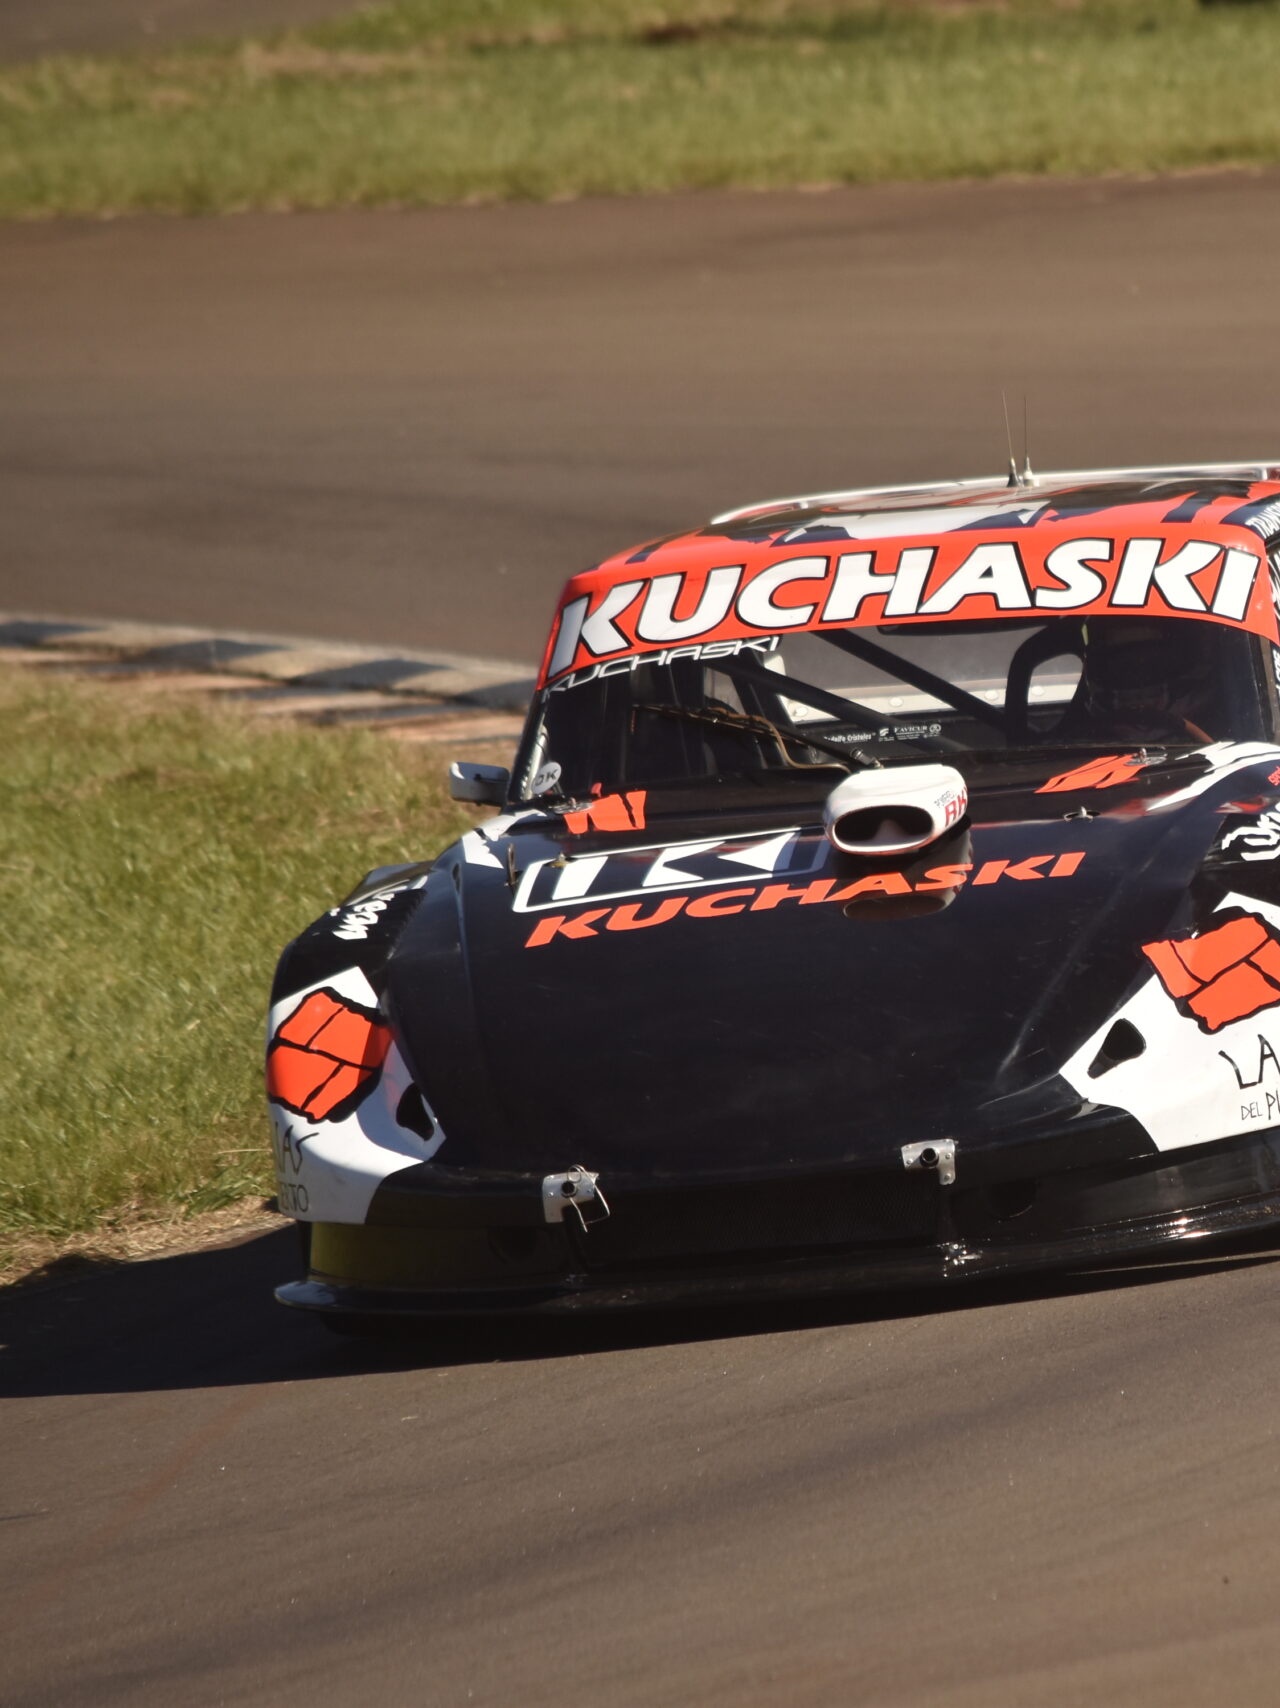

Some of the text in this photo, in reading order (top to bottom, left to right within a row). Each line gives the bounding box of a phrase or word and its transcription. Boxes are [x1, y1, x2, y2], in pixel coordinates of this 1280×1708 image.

[546, 537, 1261, 678] KUCHASKI
[543, 636, 780, 692] KUCHASKI
[524, 852, 1086, 948] KUCHASKI
[1241, 1101, 1263, 1121] DEL
